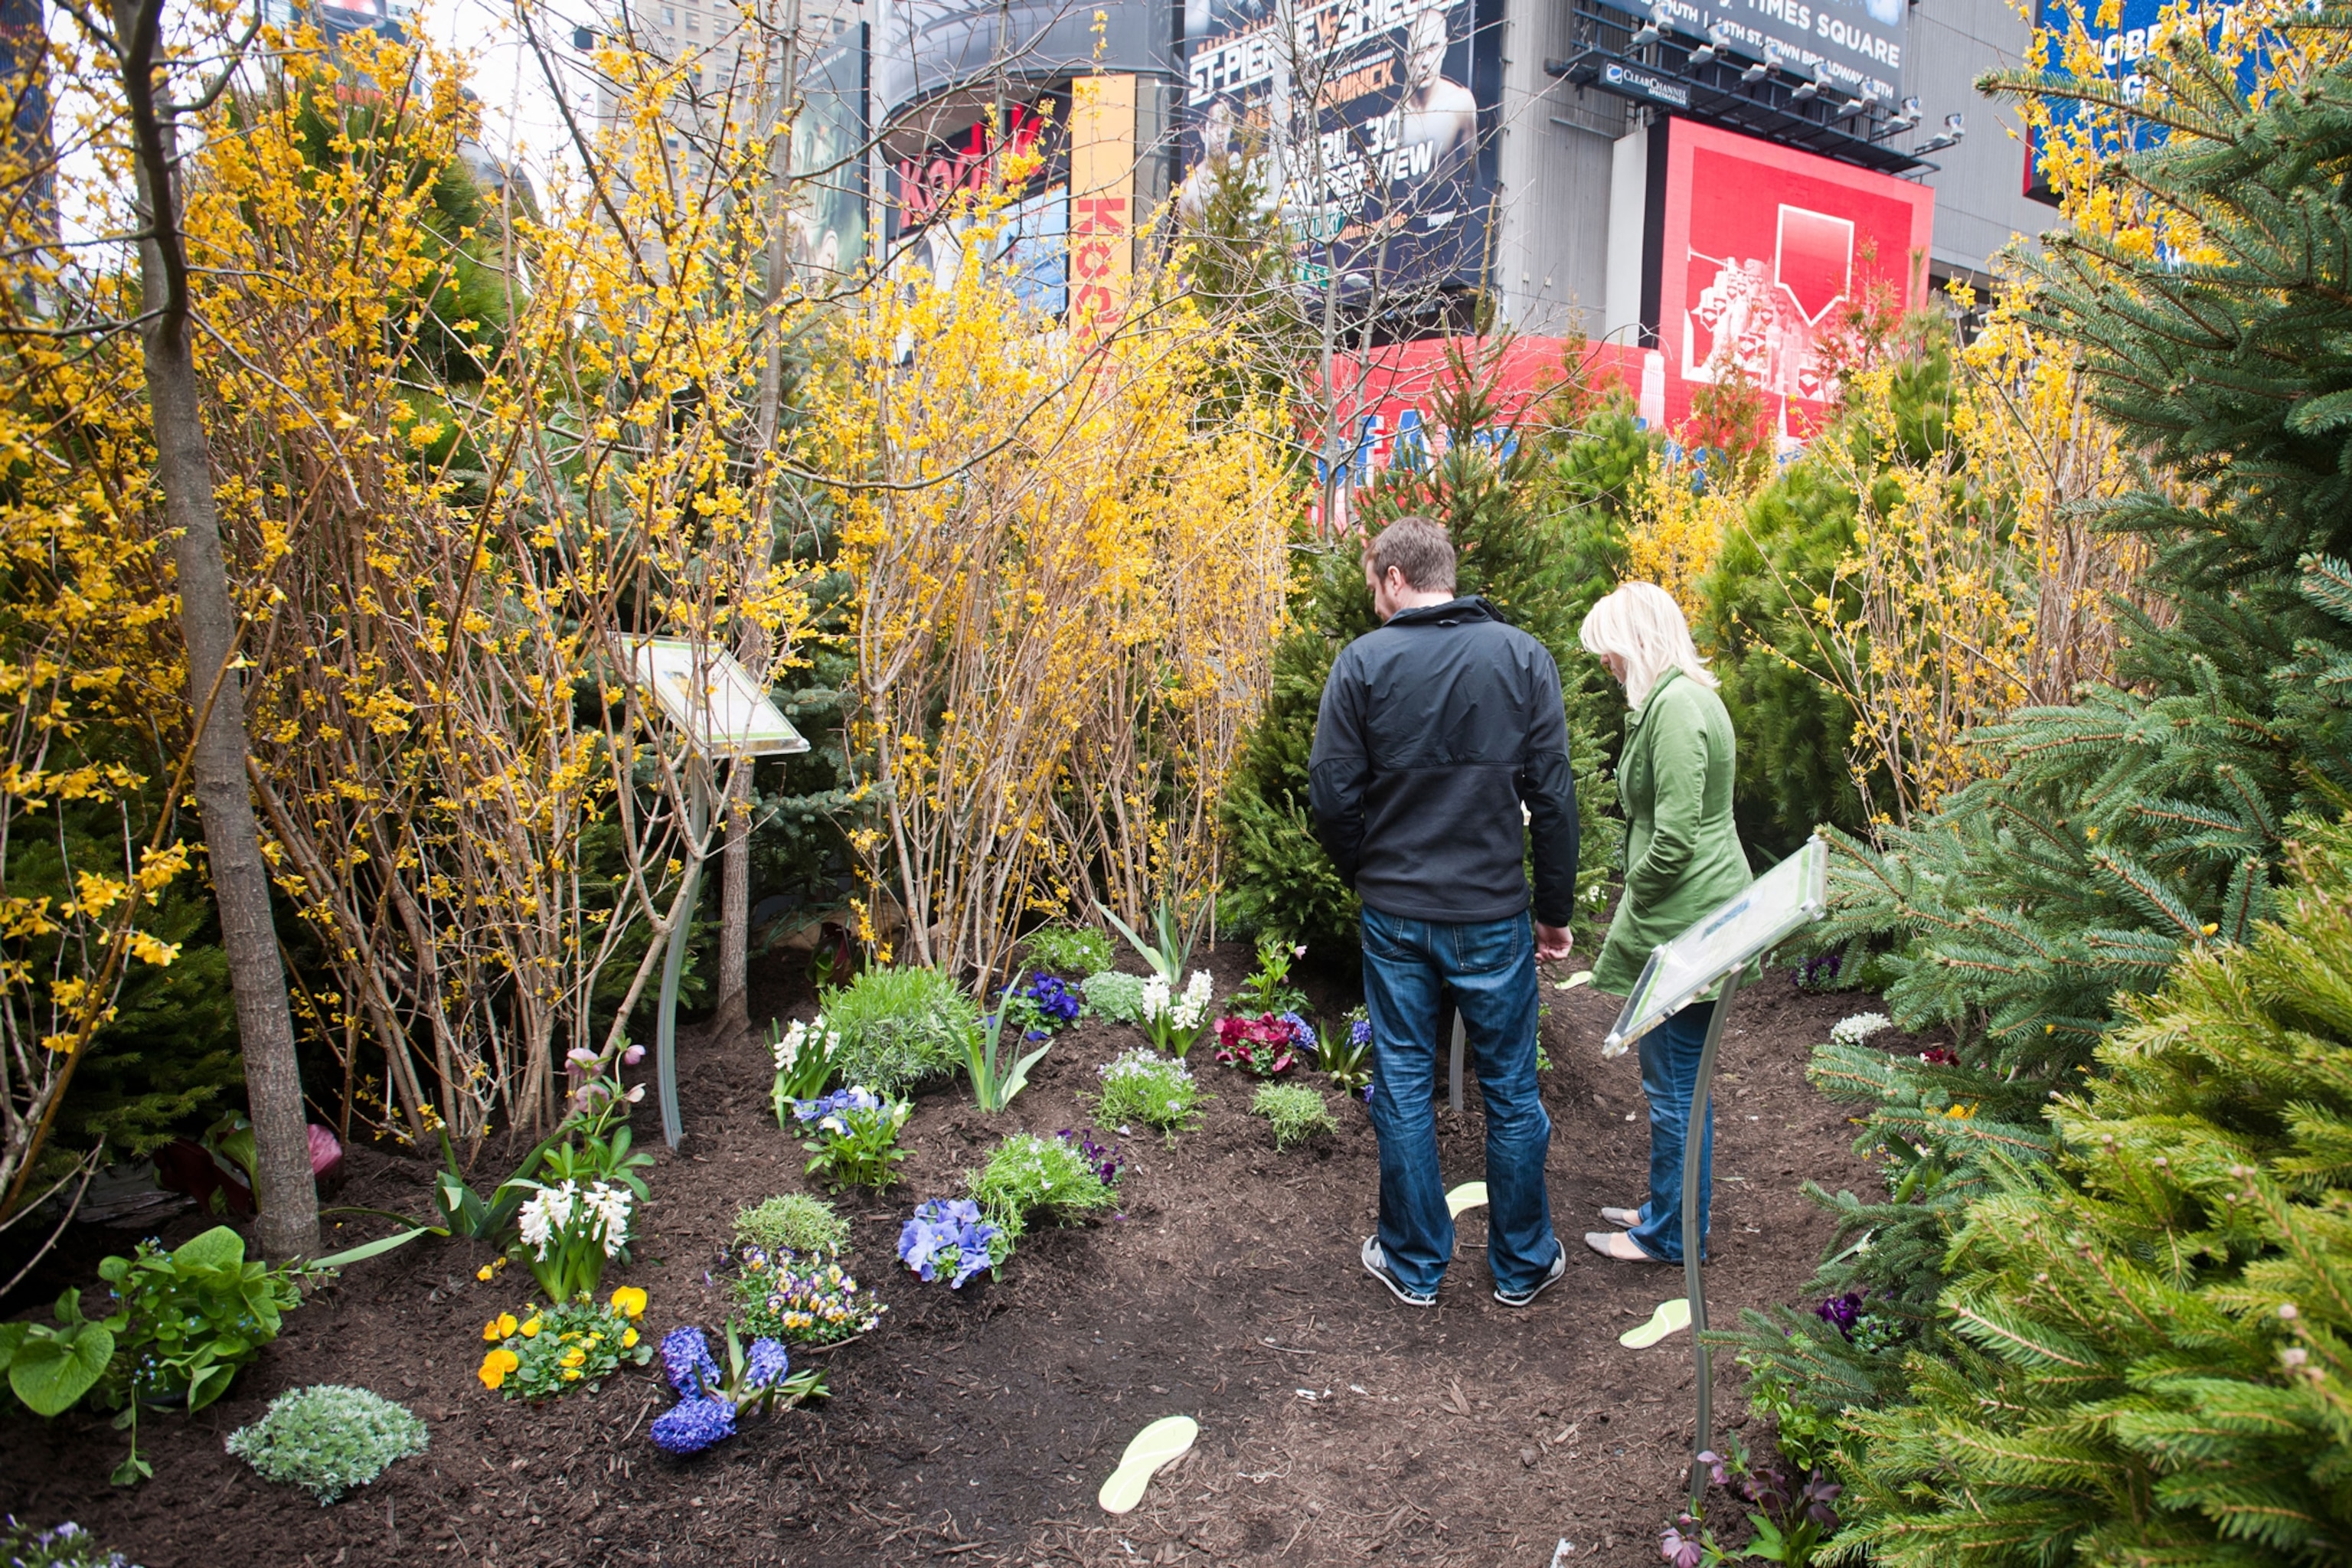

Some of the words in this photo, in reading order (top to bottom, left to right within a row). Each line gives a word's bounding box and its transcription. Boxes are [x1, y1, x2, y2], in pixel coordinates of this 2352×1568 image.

[1765, 35, 1800, 61] DWN
[1817, 13, 1900, 69] SQUARE
[1365, 109, 1401, 157] 30
